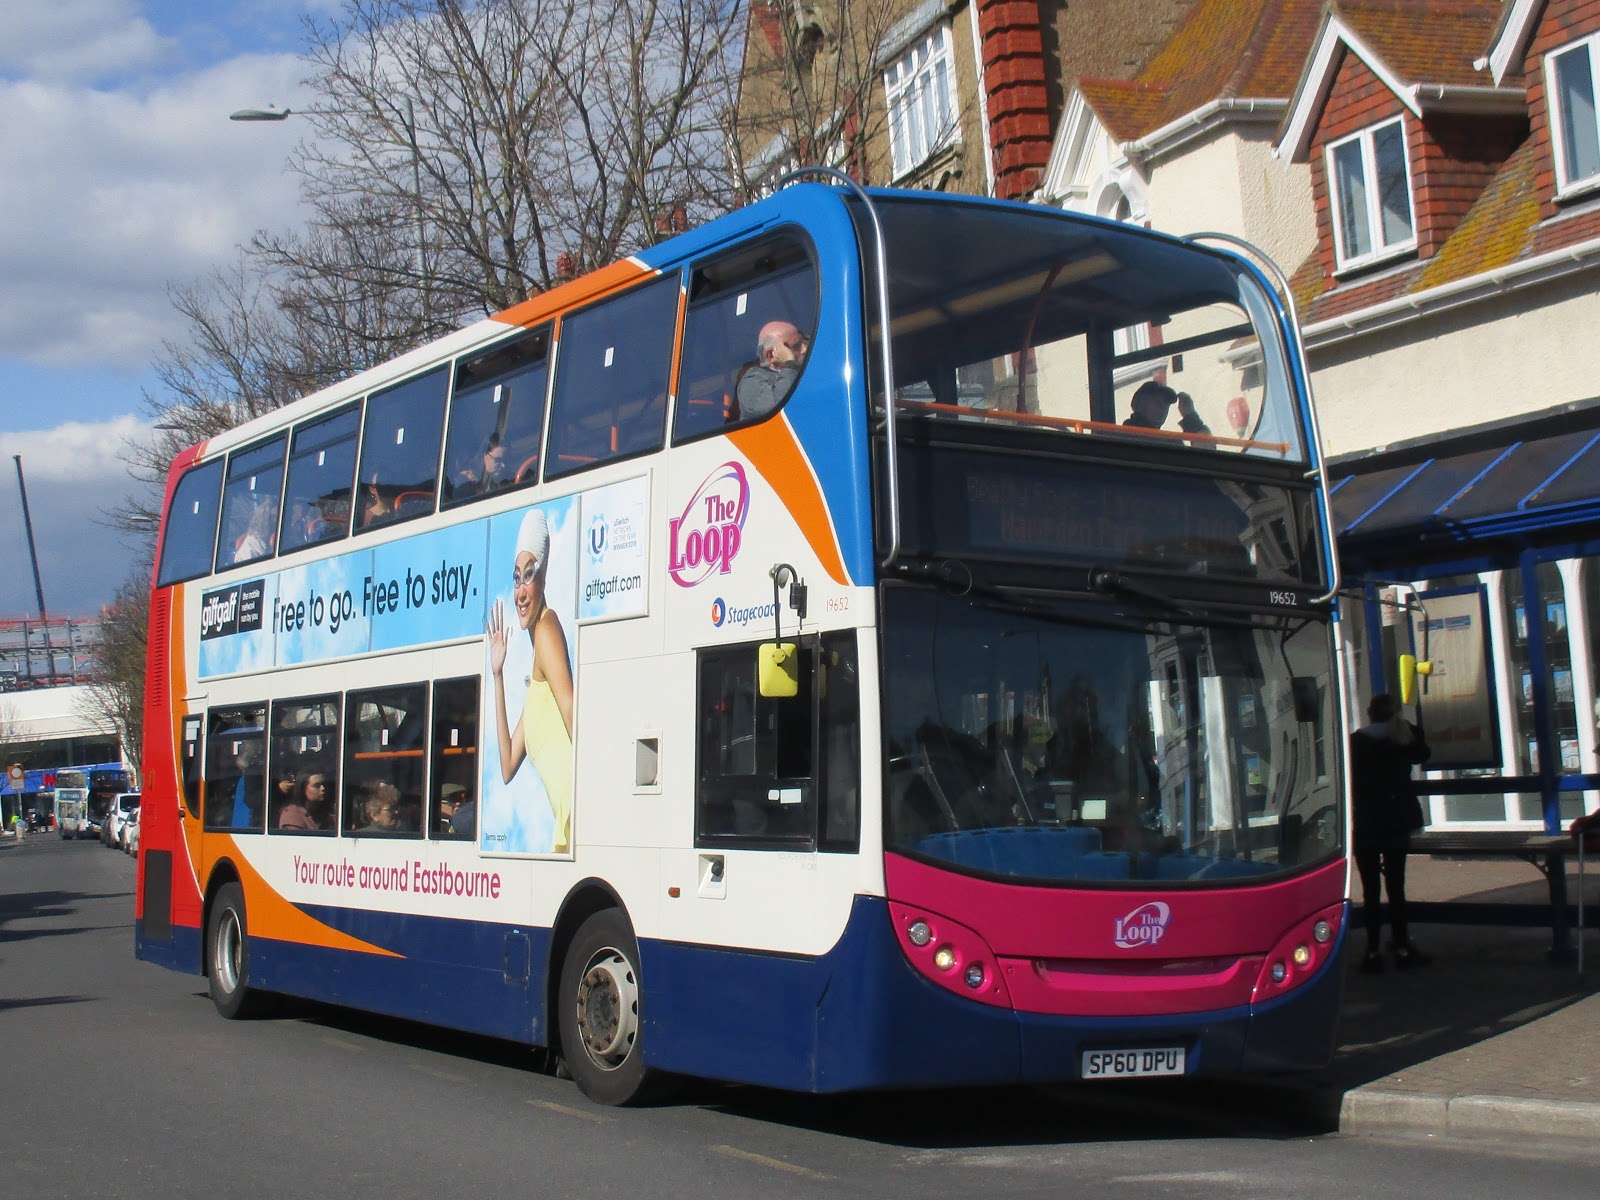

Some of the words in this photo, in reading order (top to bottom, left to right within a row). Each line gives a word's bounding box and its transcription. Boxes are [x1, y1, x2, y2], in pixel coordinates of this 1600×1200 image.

[705, 494, 735, 523] The
[668, 517, 741, 575] Loop
[272, 596, 305, 634] Free
[309, 589, 324, 627] to
[329, 589, 356, 634] go.
[362, 576, 400, 618] Free
[406, 567, 426, 609] to
[432, 559, 478, 609] stay.
[586, 575, 641, 602] giffgaff.com
[1269, 590, 1297, 605] 19652
[202, 592, 237, 635] giffgaff
[826, 597, 849, 612] 19652
[294, 855, 320, 885] Your
[322, 858, 355, 888] route
[359, 860, 408, 892] around
[414, 861, 500, 899] Eastbourne
[1116, 920, 1164, 944] Loop
[1140, 914, 1160, 925] The
[1090, 1052, 1136, 1074] SP60
[1142, 1050, 1177, 1072] DPU
